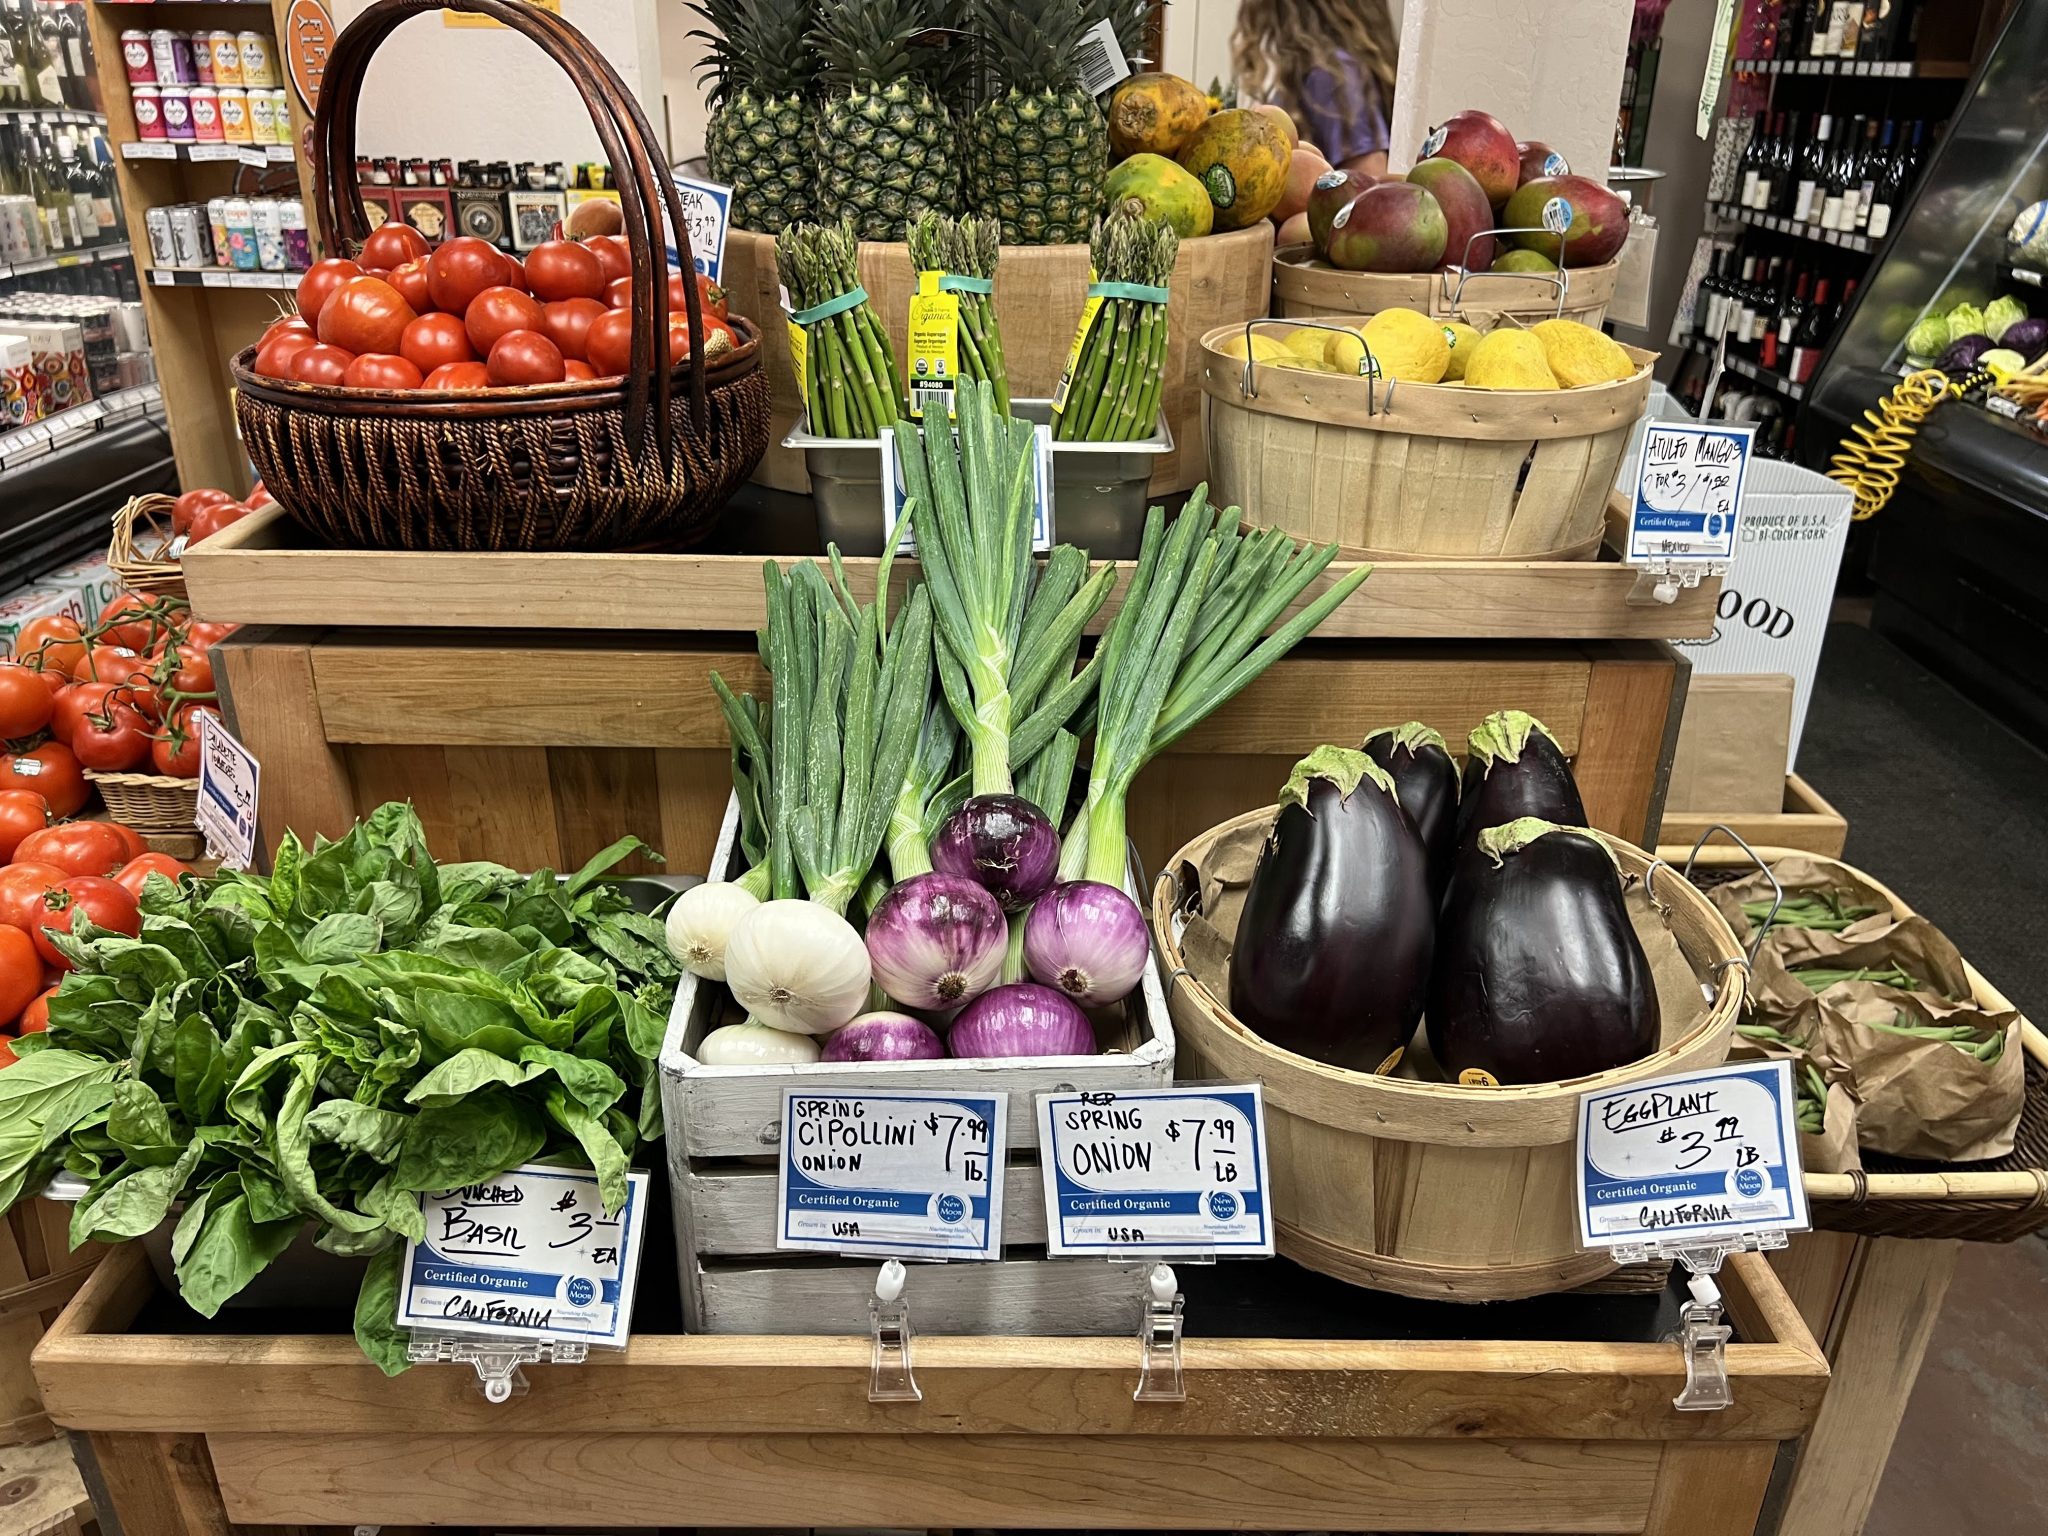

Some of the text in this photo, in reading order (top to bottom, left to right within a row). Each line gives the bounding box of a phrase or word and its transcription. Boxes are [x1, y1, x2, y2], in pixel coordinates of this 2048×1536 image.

[919, 380, 944, 389] #94080
[1694, 432, 1743, 464] MANGOS
[1655, 473, 1670, 489] FOR
[1717, 499, 1730, 513] EA
[1640, 516, 1692, 528] Certified Organic
[1743, 514, 1829, 528] PRODUCE OF U.S.A.
[1661, 539, 1690, 554] MEXICO
[1065, 1107, 1143, 1130] SPRING
[923, 1112, 988, 1173] $7.99
[1165, 1118, 1235, 1172] $7.99
[964, 1159, 988, 1182] lb.
[1215, 1161, 1238, 1183] LB
[1739, 1173, 1758, 1182] New
[1596, 1180, 1698, 1201] Certified Organic
[1738, 1182, 1762, 1190] Moon
[798, 1193, 900, 1209] Certified Organic
[942, 1199, 961, 1208] New
[1070, 1198, 1172, 1211] Certified Organic
[1213, 1195, 1232, 1205] New
[939, 1207, 963, 1216] Moon
[1211, 1204, 1236, 1213] Moon
[1639, 1203, 1733, 1230] CALIFORNIA
[439, 1206, 527, 1250] BASIL
[832, 1222, 861, 1237] USA
[1107, 1227, 1145, 1243] USA
[592, 1246, 618, 1266] EA
[424, 1269, 529, 1290] Certified Organic
[572, 1282, 591, 1292] New
[568, 1290, 593, 1300] Moon
[443, 1295, 553, 1330] CALIFORNIA
